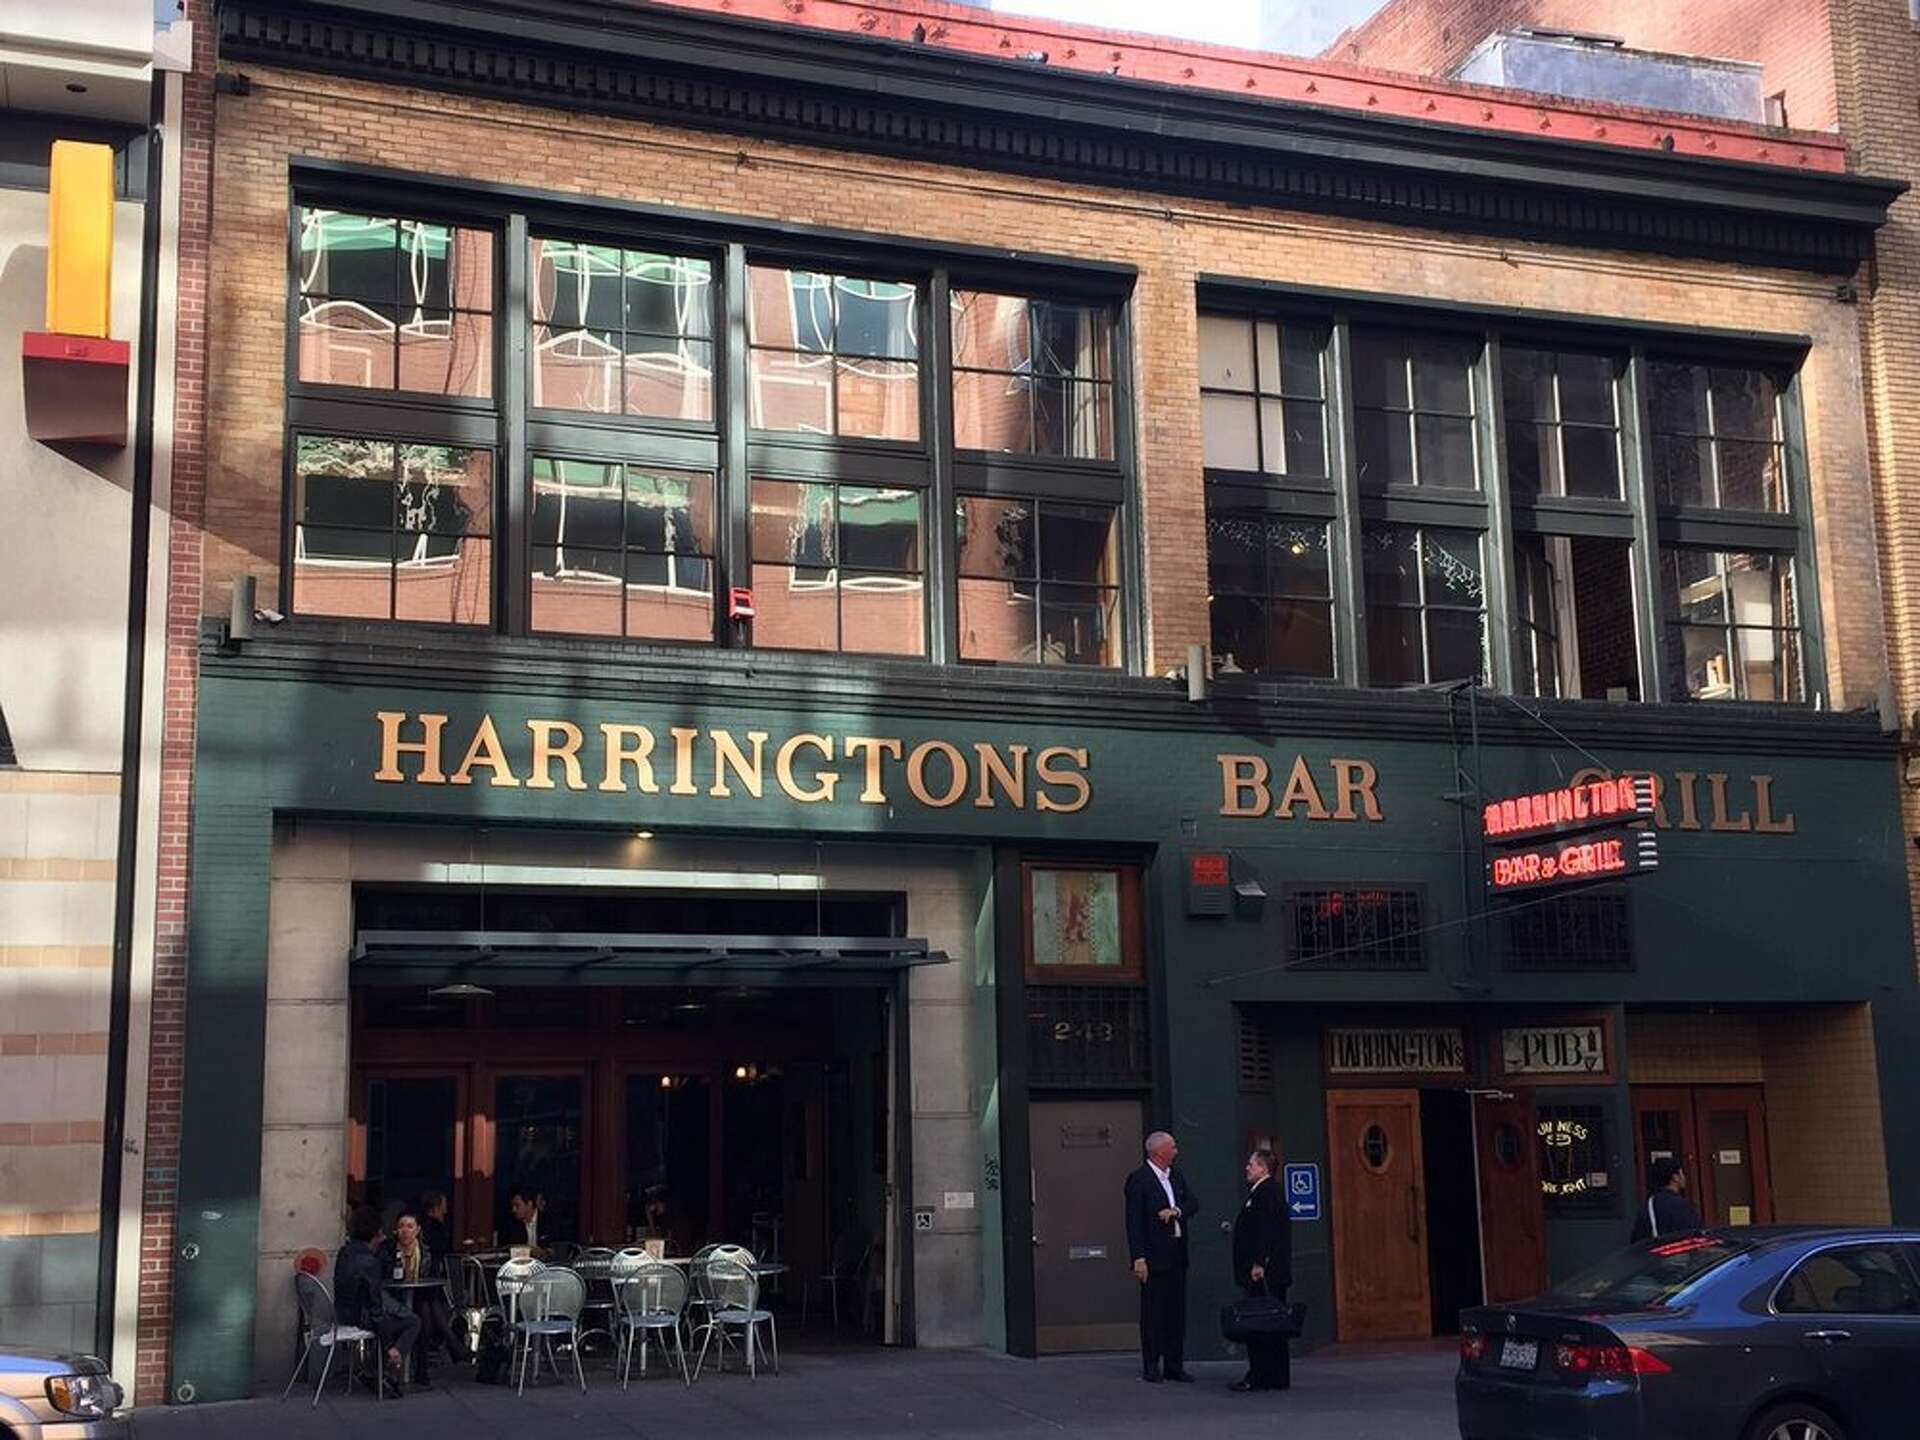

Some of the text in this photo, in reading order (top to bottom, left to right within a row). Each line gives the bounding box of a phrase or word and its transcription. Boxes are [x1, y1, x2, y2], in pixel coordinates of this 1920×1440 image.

[373, 710, 1092, 813] HARRINGTONS
[1217, 753, 1383, 822] BAR
[1494, 852, 1541, 887] BAR
[1524, 1033, 1583, 1066] PUB
